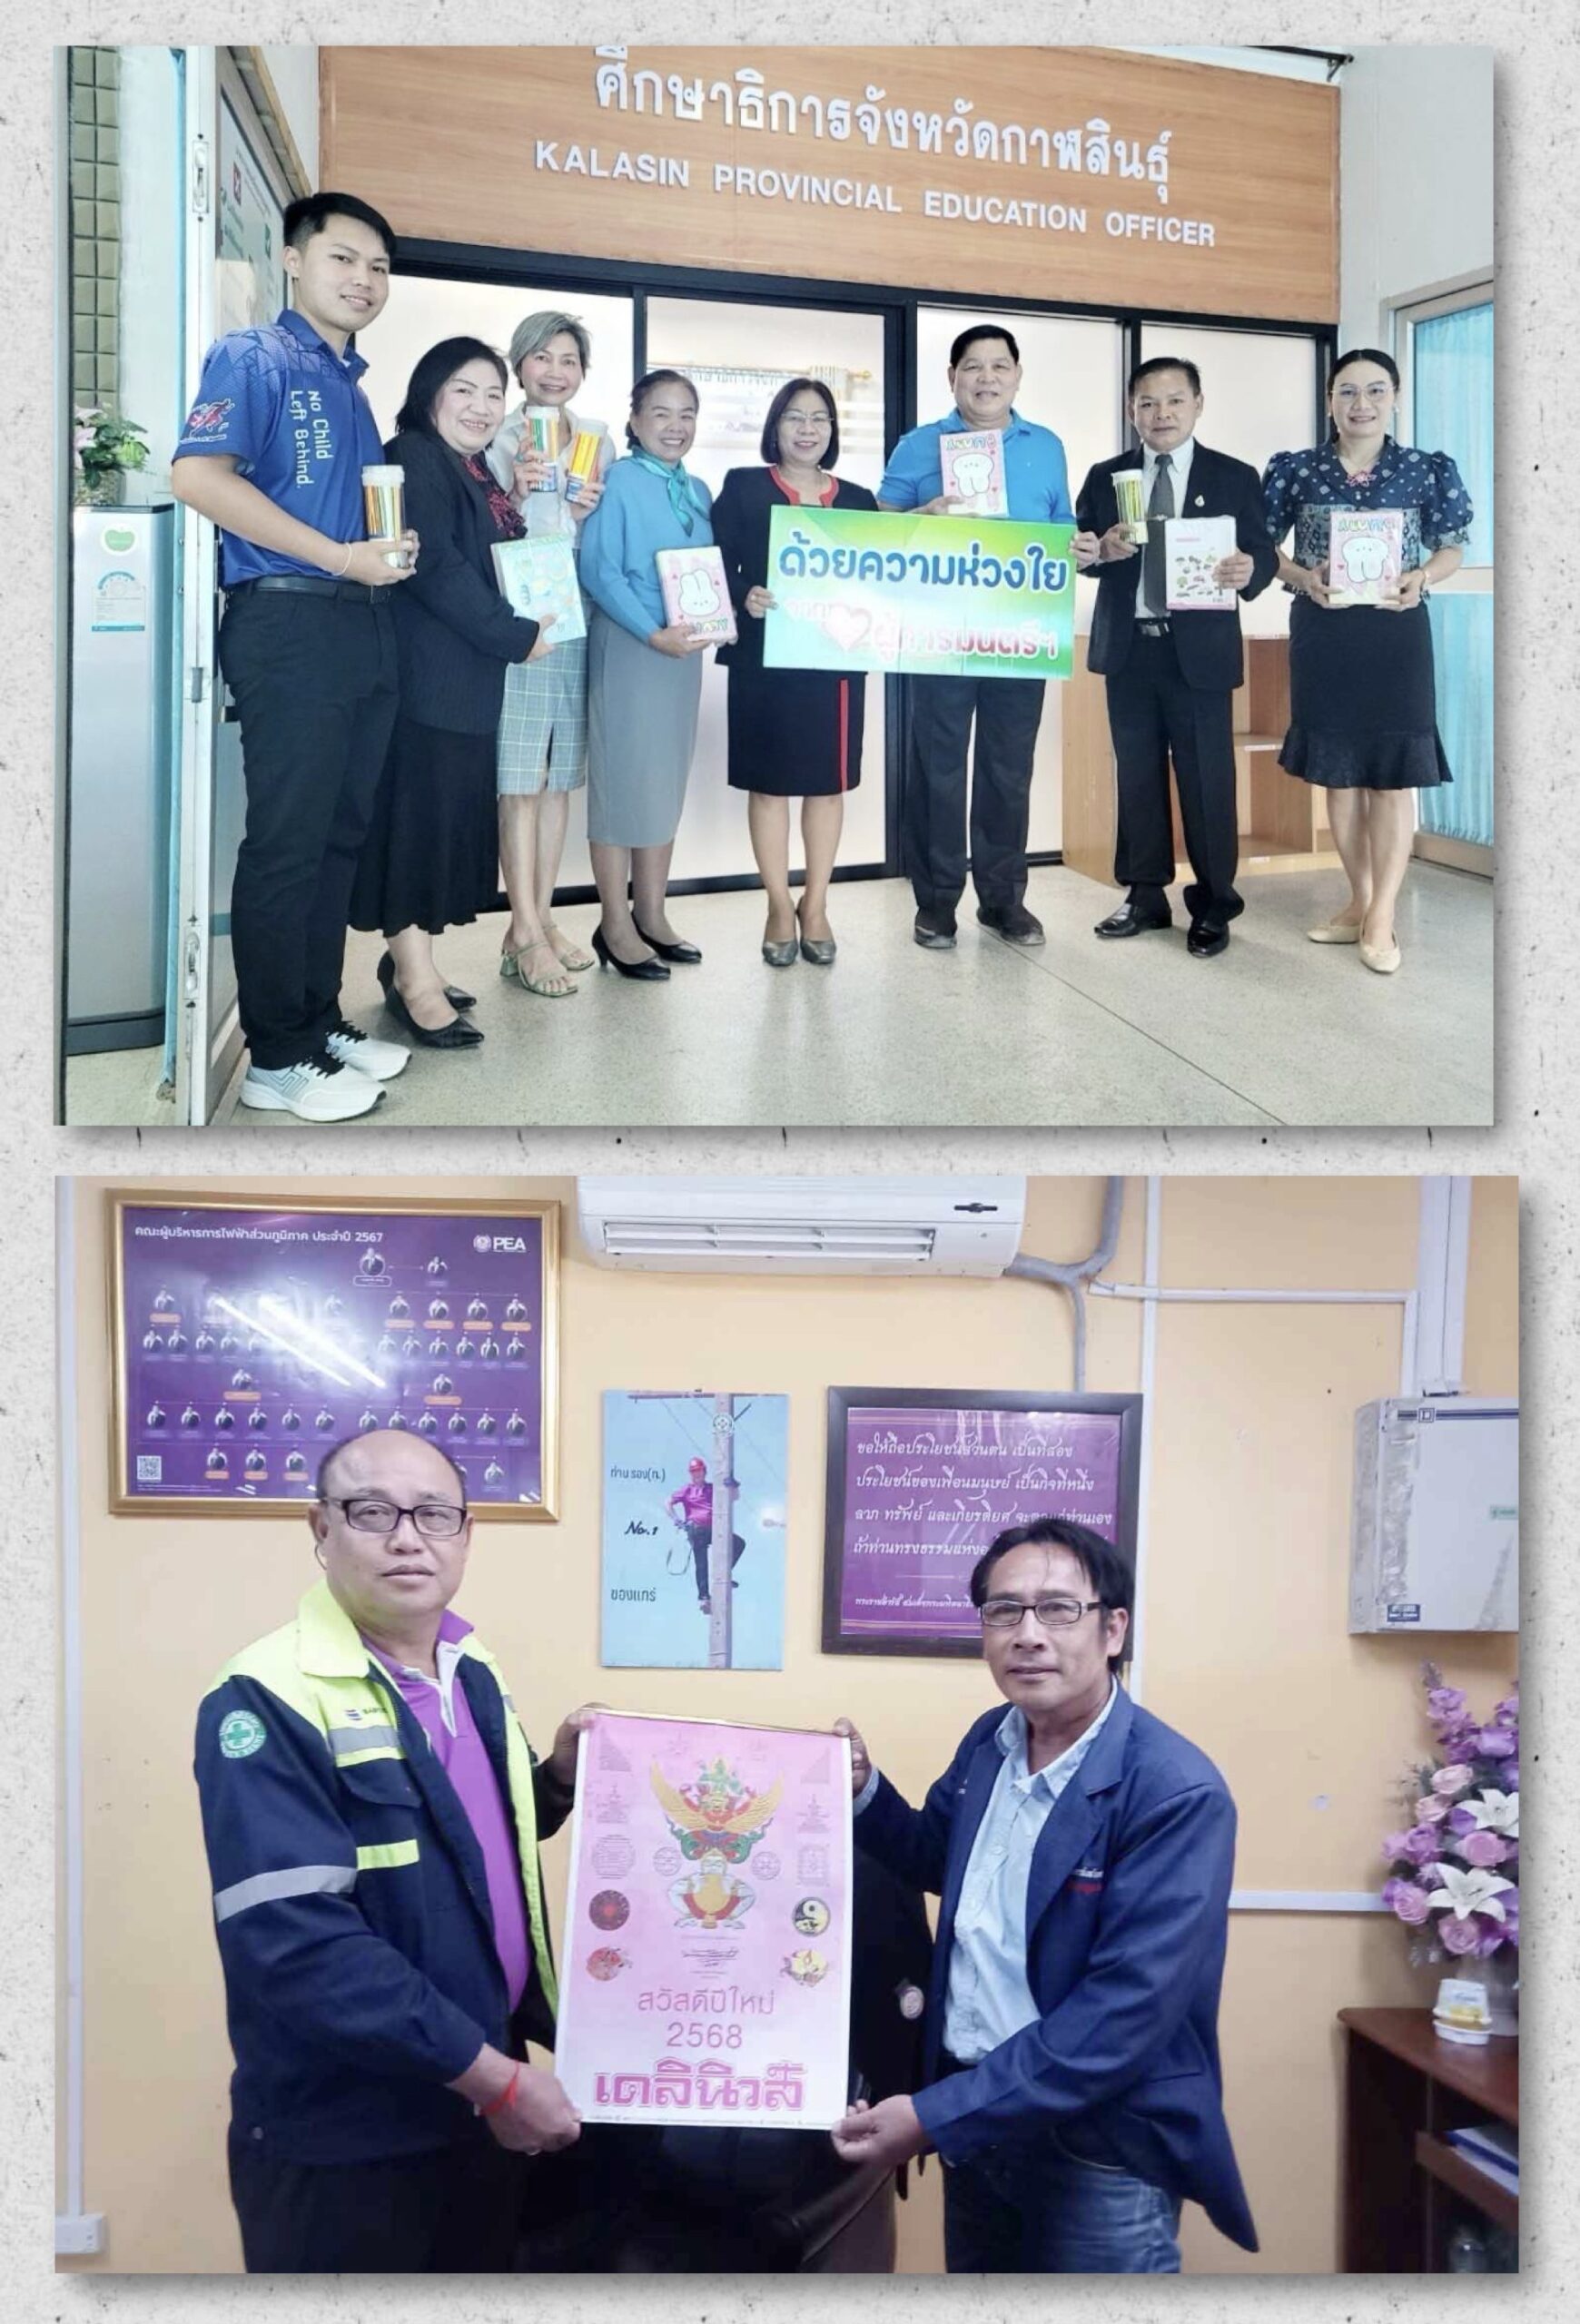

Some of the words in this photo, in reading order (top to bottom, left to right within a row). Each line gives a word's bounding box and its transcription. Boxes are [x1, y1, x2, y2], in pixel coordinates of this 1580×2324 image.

[595, 44, 1171, 204] ศึกษาธิการจังหวัดกาฬสินธุ์
[535, 140, 690, 188] KALASIN
[715, 163, 903, 213] PROVINCIAL
[923, 190, 1087, 233] EDUCATION
[1105, 211, 1216, 247] OFFICER
[289, 390, 308, 421] Left
[308, 390, 321, 412] No
[312, 419, 334, 459] Child
[293, 429, 315, 489] Behind.
[778, 530, 1068, 592] ด้วยความห่วงใย
[134, 1226, 309, 1244] คณะผู้บริหารการไฟฟ้าส่วนภูมิภาค
[312, 1230, 351, 1242] ประจำปี
[355, 1232, 383, 1243] 2567
[493, 1237, 527, 1251] PEA
[884, 1499, 933, 1521] ทรัพย์
[927, 1499, 1017, 1524] และเกียรติยศ
[854, 1534, 989, 1556] ถ้าท่านทรงธรรมแห่งอ
[637, 1985, 775, 2015] สวัสดีปีใหม่
[666, 2022, 743, 2050] 2568
[595, 2056, 806, 2111] เดลินิวส์
